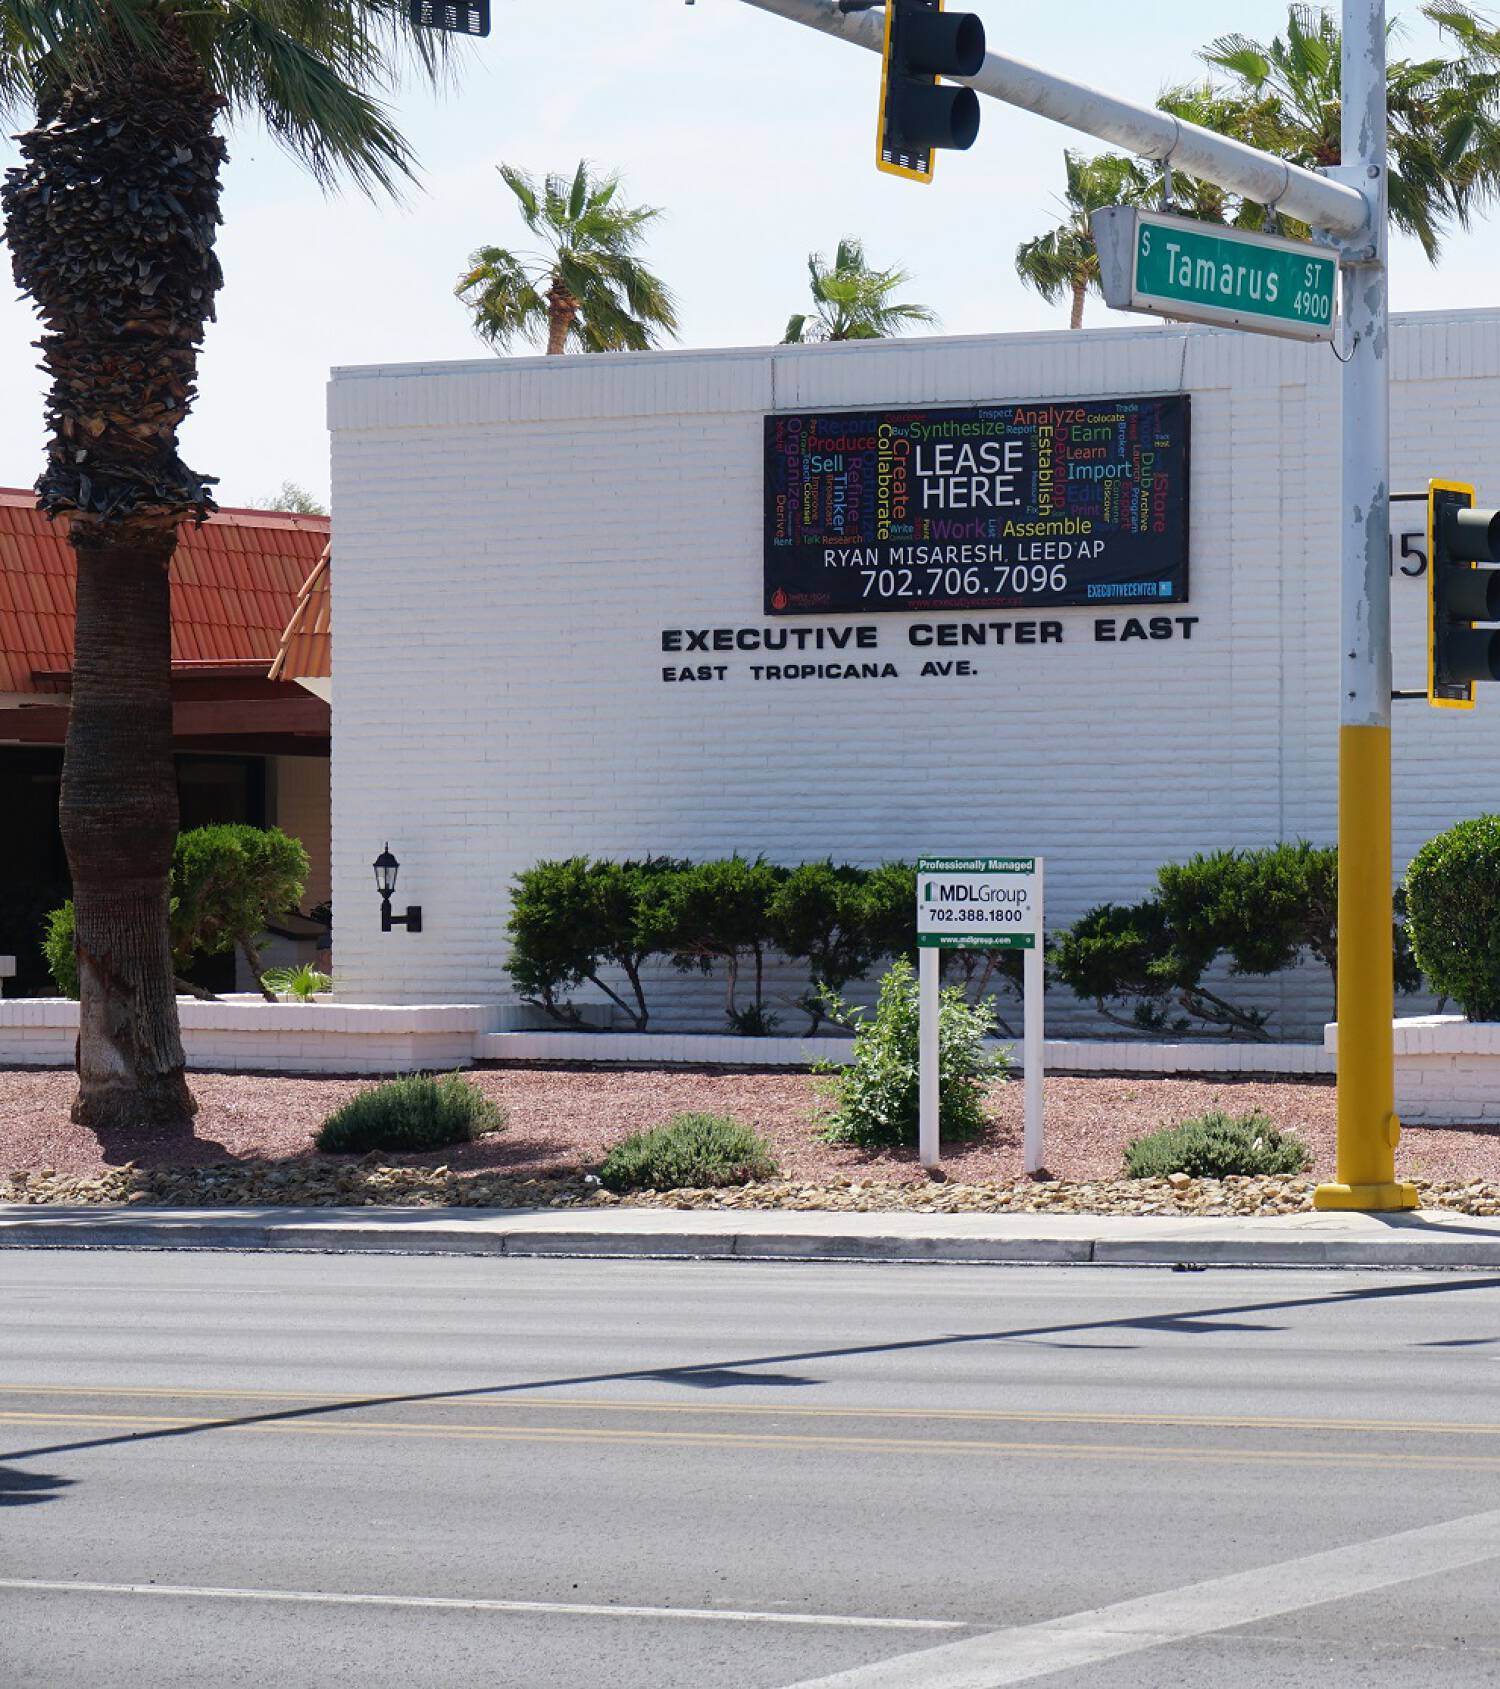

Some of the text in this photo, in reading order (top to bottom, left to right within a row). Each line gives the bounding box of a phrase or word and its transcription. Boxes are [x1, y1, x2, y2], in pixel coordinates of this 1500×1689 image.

[1141, 231, 1323, 303] S Tamarus ST
[1293, 290, 1329, 319] 4900
[979, 407, 1014, 420] Inspect
[1013, 406, 1086, 427] Analyze
[1088, 413, 1125, 424] Colocate
[808, 434, 877, 453] Produce
[892, 426, 909, 438] Buy
[910, 419, 1005, 441] Synthesize
[1006, 424, 1037, 435] Report
[1071, 425, 1112, 442] Earn
[1118, 421, 1126, 458] Broker
[784, 417, 802, 511] Organize
[811, 454, 844, 472] Sell
[916, 441, 1024, 476] LEASE
[1066, 446, 1107, 460] Learn
[877, 423, 893, 541] Collaborate
[893, 437, 911, 519] Create
[1039, 425, 1054, 516] Establish
[1052, 427, 1070, 511] Develop
[1067, 461, 1132, 484] Import
[1141, 452, 1155, 488] Dub
[847, 456, 863, 522] Refine
[923, 474, 1021, 509] HERE.
[1104, 479, 1112, 524] Discover
[776, 494, 787, 538] Derive
[803, 482, 812, 525] Counsel
[833, 472, 847, 535] Tinker
[1141, 490, 1151, 533] Archive
[1152, 476, 1169, 536] Store
[822, 534, 864, 545] Research
[931, 516, 986, 539] Work
[1003, 516, 1092, 537] Assemble
[824, 547, 878, 567] RYAN
[1018, 541, 1072, 561] LEED
[1077, 540, 1105, 559] AP
[860, 564, 1067, 598] 702.706.7096
[662, 616, 1199, 651] EXECUTIVE CENTER EAST
[662, 660, 978, 682] EAST TROPICANA AVE.
[919, 859, 1033, 871] Professionally Managed
[940, 884, 1027, 906] MDLGroup
[929, 909, 1022, 922] 702.388.1800
[940, 935, 1011, 945] www.mdlgroup.com
